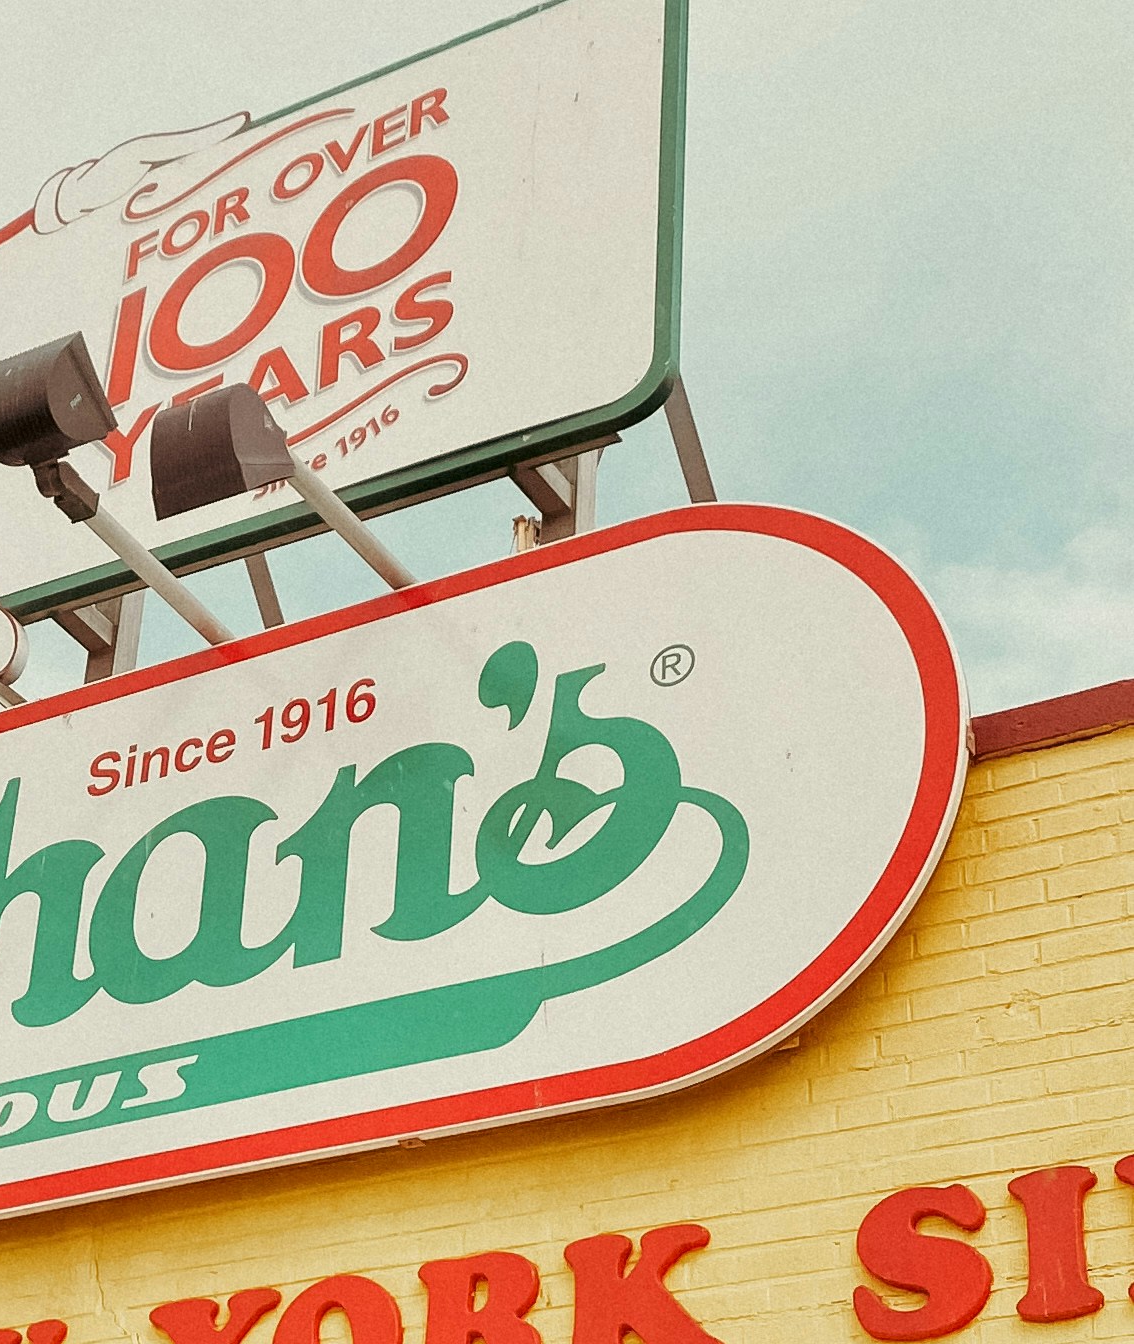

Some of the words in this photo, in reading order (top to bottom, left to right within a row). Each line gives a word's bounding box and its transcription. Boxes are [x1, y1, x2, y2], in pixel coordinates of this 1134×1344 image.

[126, 187, 251, 280] FOR
[272, 87, 452, 200] OVER
[106, 154, 459, 408] 100
[101, 271, 455, 484] YARS
[334, 404, 400, 458] 1916
[86, 729, 237, 798] Since
[256, 678, 377, 751] 1916
[852, 1155, 1134, 1343] SI
